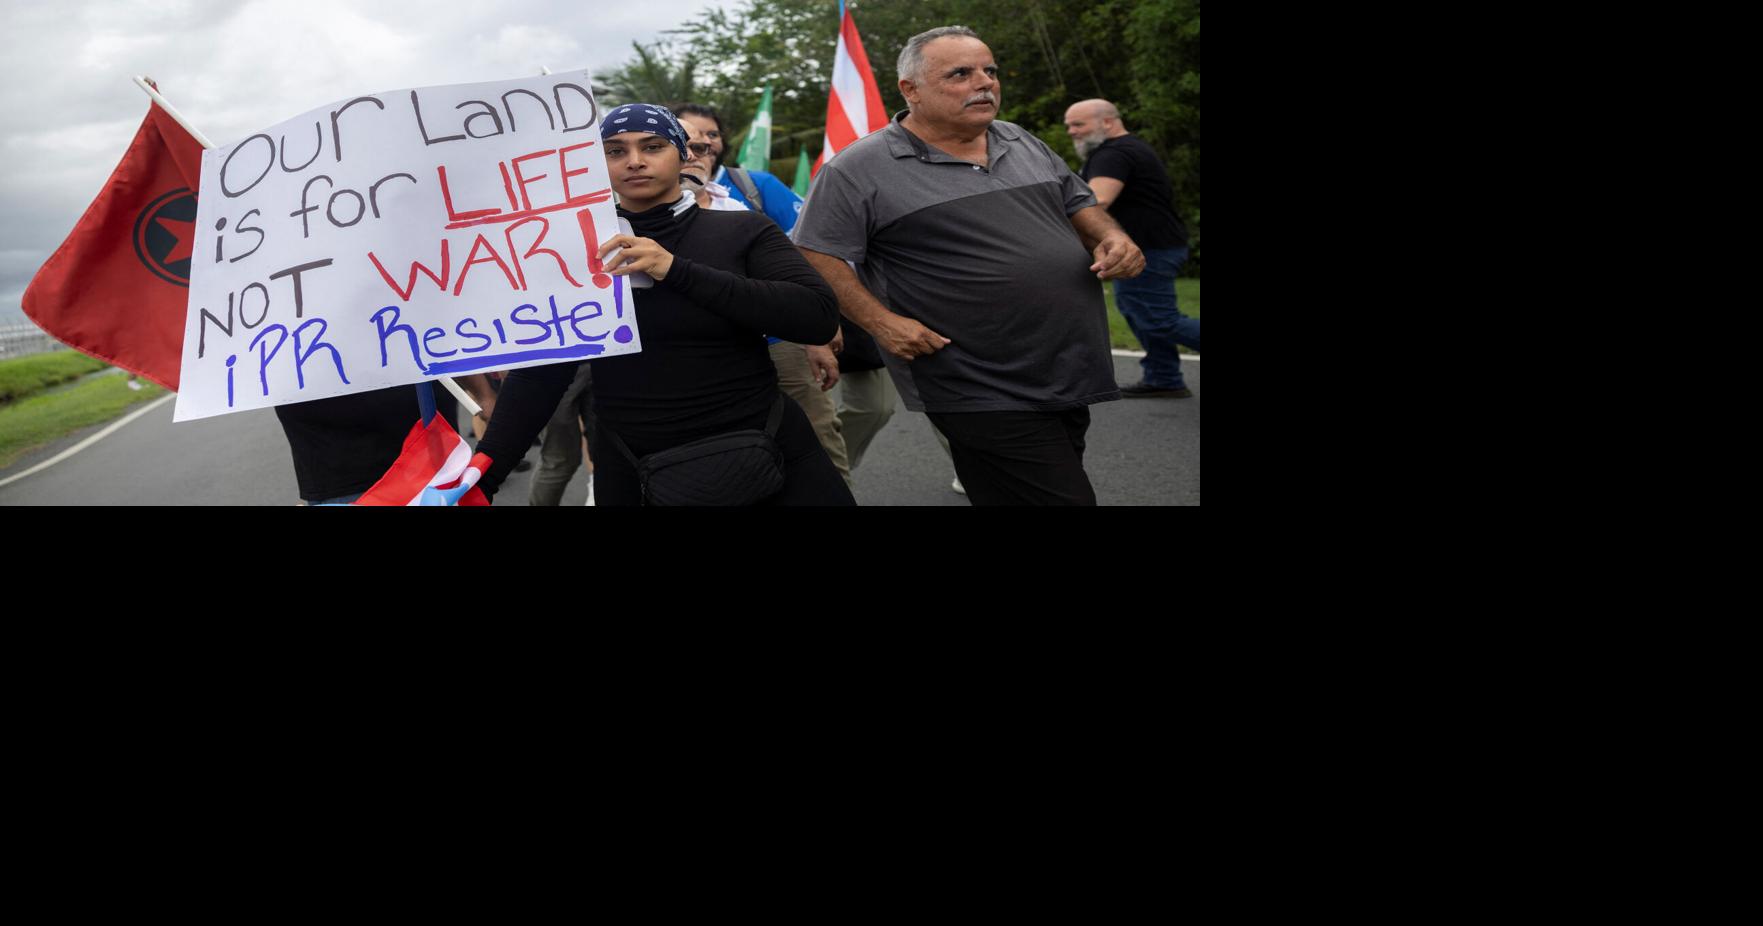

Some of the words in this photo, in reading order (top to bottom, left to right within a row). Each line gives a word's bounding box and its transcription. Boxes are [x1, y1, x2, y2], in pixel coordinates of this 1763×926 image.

[214, 208, 265, 263] is
[290, 173, 417, 238] for
[437, 141, 612, 222] LIFE
[198, 257, 333, 358] NOT
[367, 208, 613, 301] WAR!
